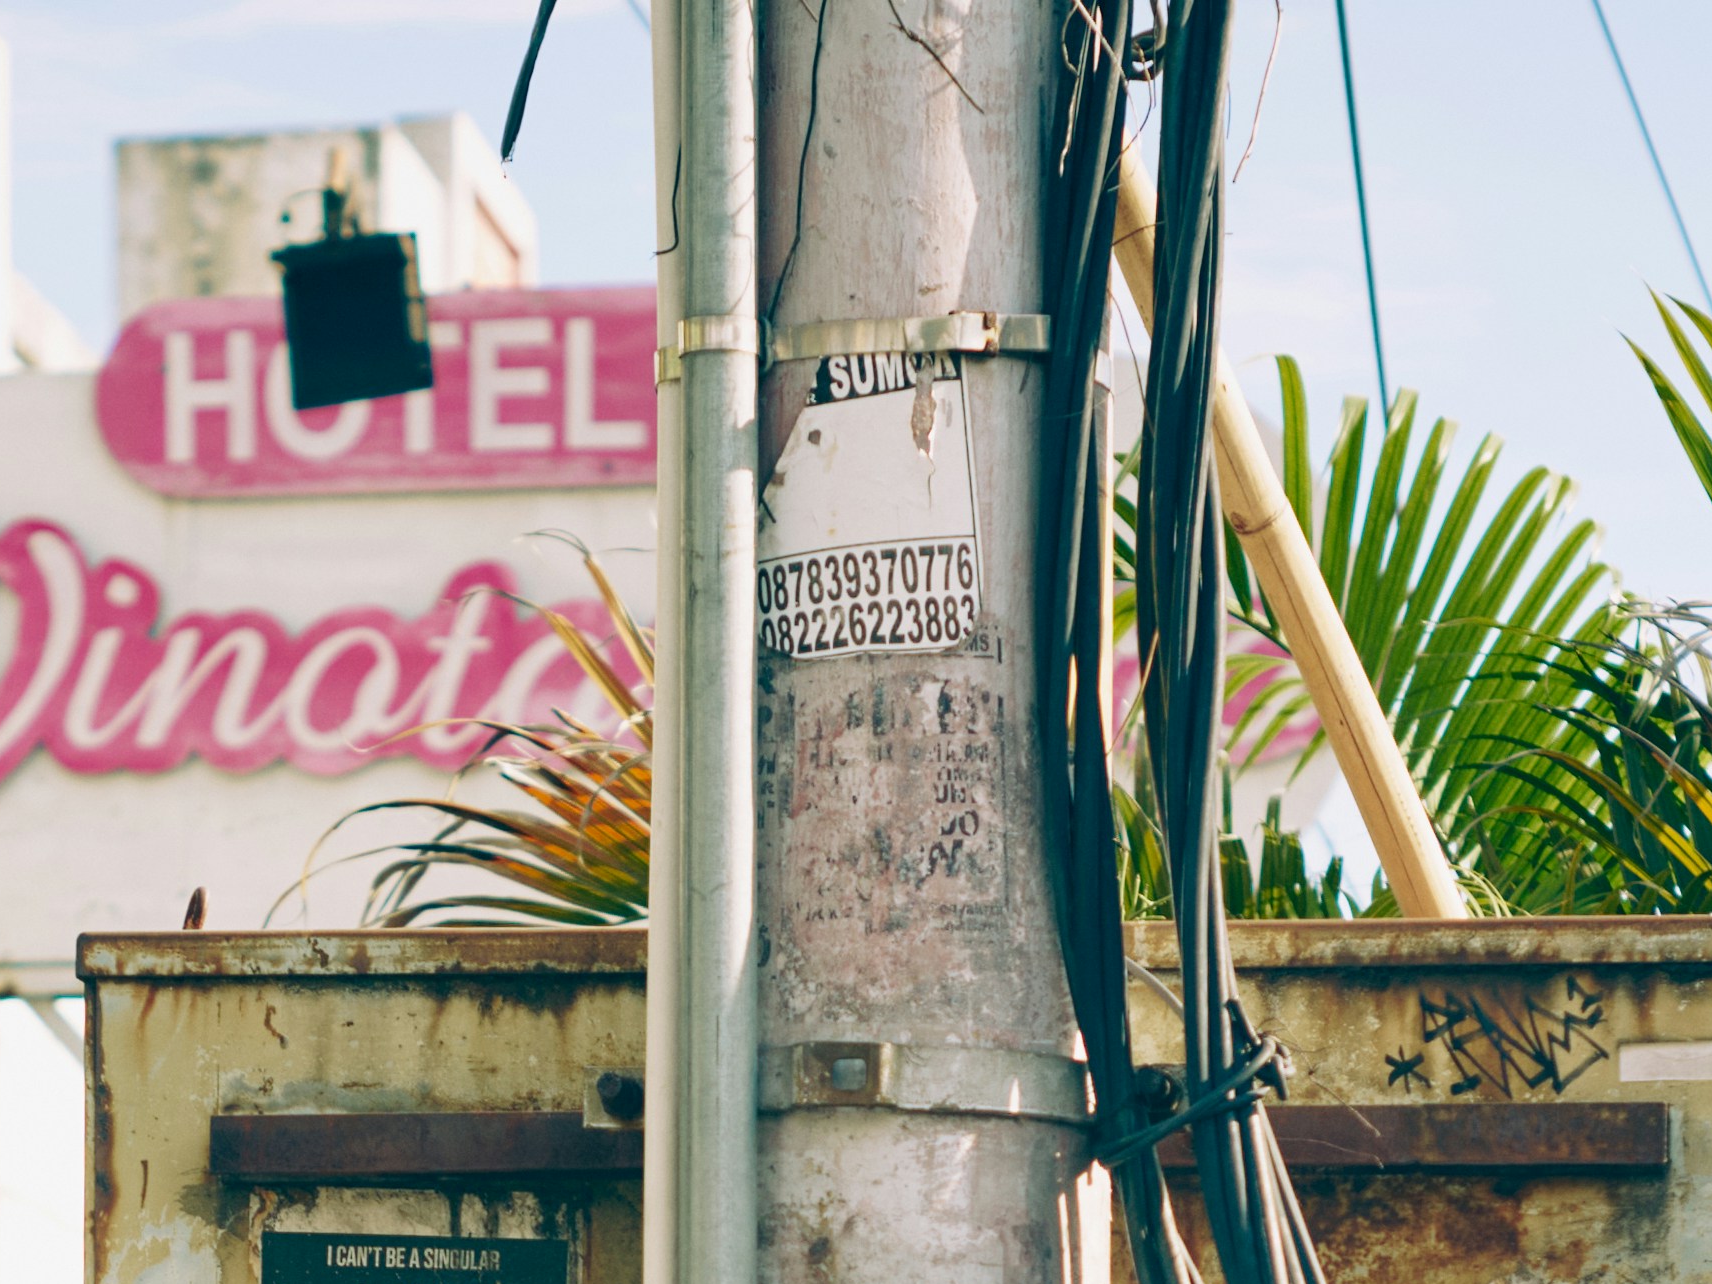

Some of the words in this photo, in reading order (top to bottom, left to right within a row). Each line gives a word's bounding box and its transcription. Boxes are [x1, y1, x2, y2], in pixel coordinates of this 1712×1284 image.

[757, 542, 974, 615] 087839370776
[326, 1244, 333, 1267] I
[336, 1245, 383, 1268] CAN'T
[385, 1246, 406, 1269] BE
[408, 1247, 421, 1269] A
[423, 1247, 501, 1271] SINGULAR
